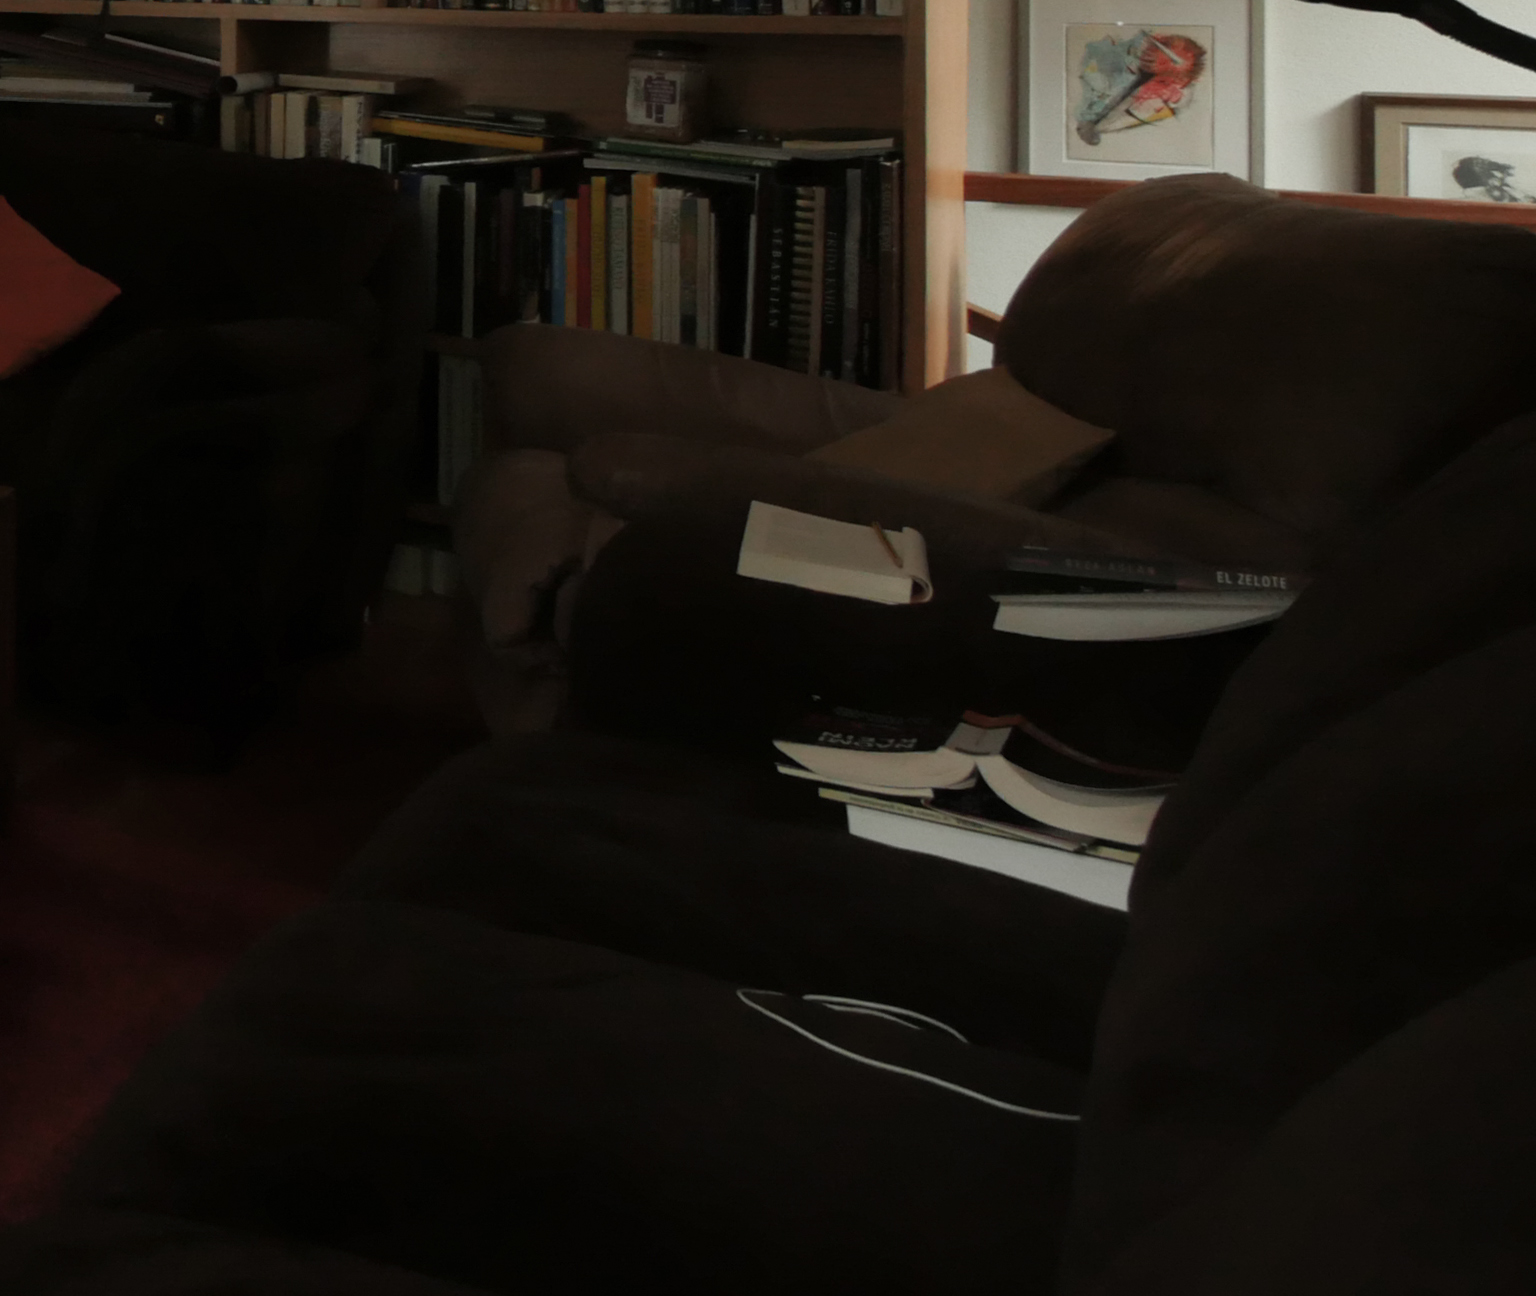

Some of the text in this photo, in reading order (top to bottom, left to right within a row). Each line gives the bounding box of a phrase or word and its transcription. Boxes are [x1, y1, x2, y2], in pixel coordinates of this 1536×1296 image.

[824, 231, 837, 324] FRIDA KAHLO
[1216, 571, 1287, 590] EL ZELOTE
